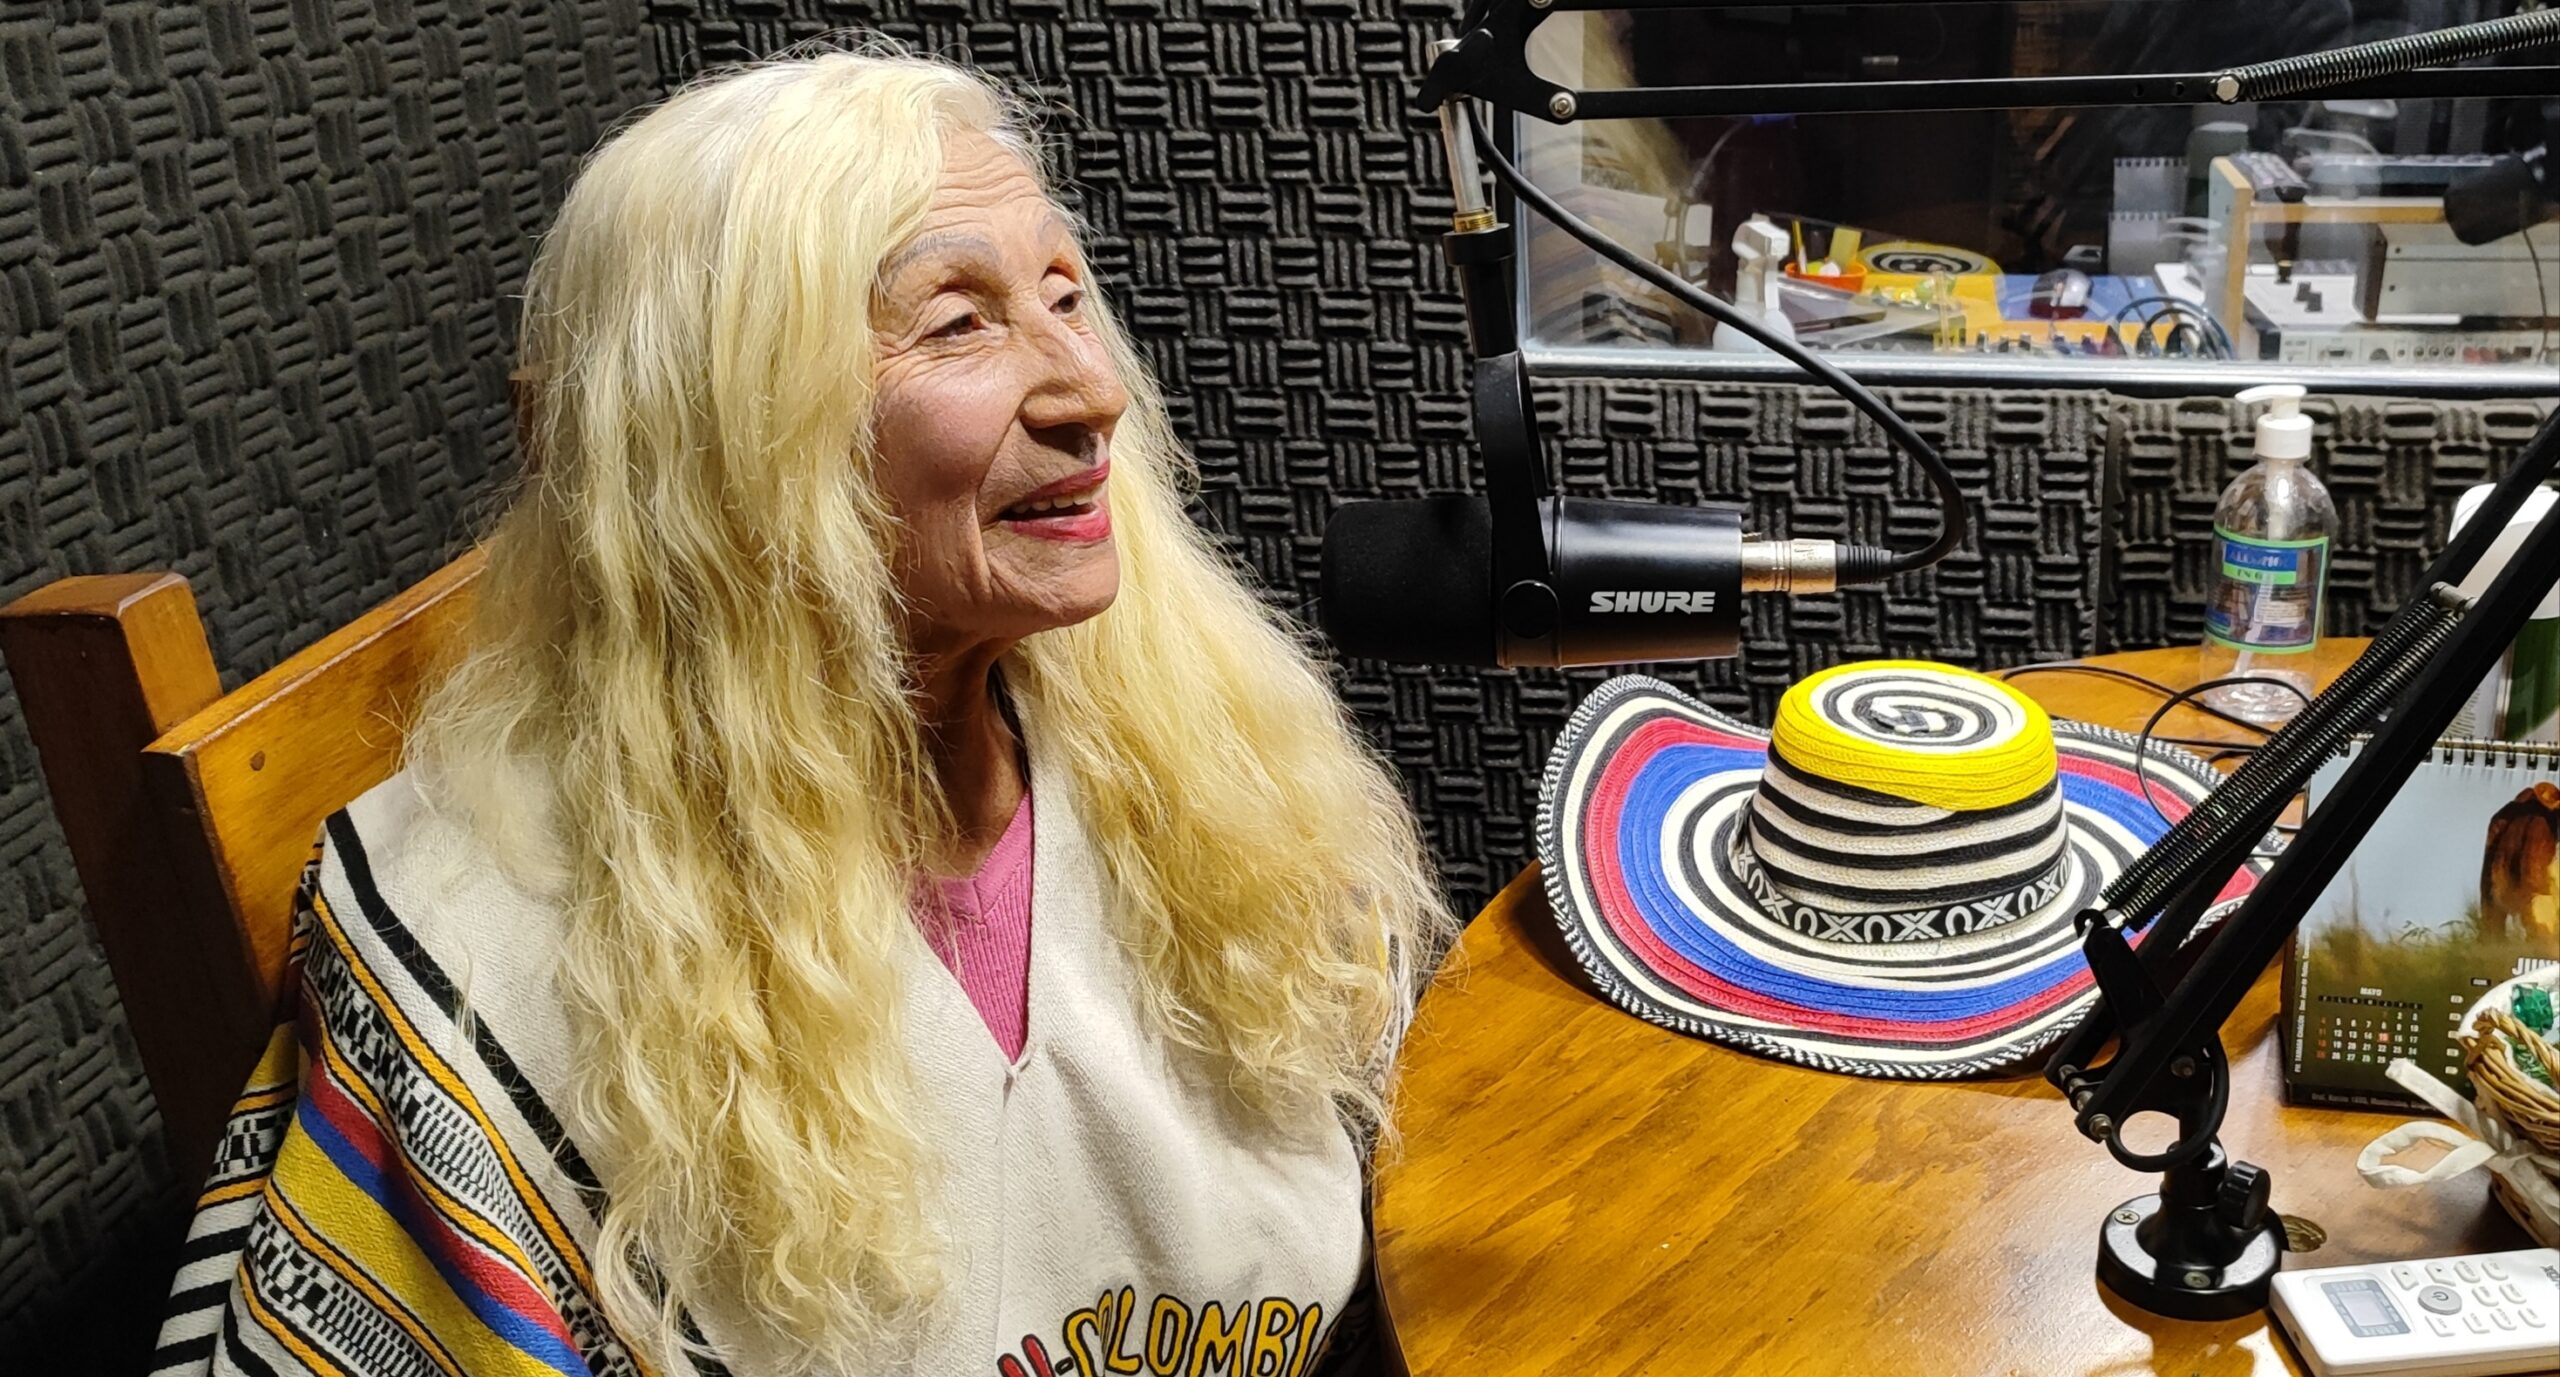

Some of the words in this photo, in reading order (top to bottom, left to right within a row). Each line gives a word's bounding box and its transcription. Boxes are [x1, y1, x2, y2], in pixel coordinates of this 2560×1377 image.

[1589, 591, 1716, 614] SHURE
[2364, 1032, 2373, 1040] 14
[2409, 1036, 2418, 1044] 17
[2362, 1043, 2371, 1051] 21
[2377, 1044, 2387, 1053] 22
[2346, 1053, 2356, 1061] 27
